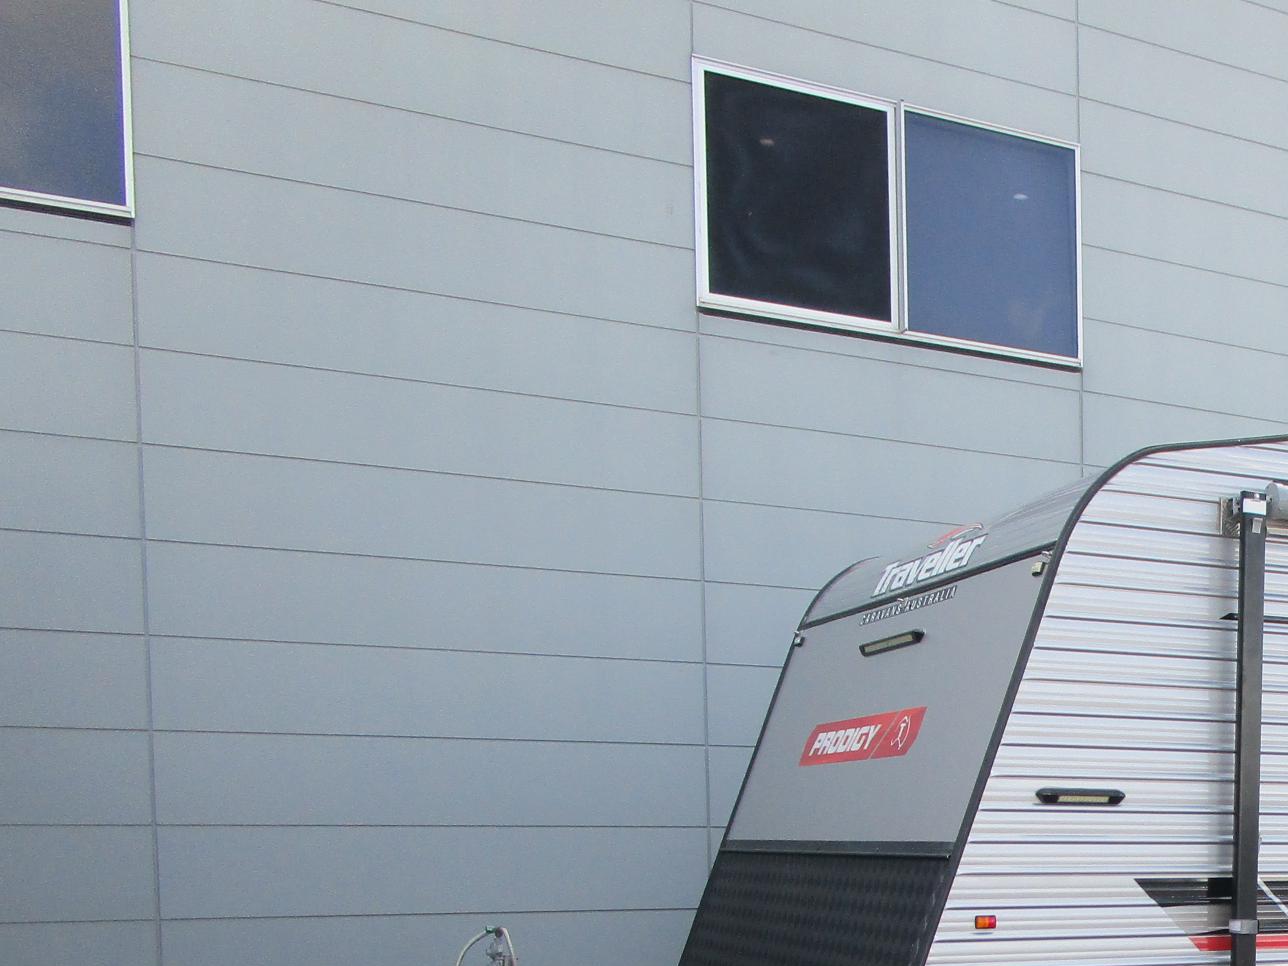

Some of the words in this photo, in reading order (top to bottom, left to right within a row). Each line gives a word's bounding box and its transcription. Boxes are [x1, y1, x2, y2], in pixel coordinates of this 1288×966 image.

[872, 534, 988, 598] Traveller
[903, 585, 958, 613] AUSTRALIA
[808, 723, 882, 757] PRODIGY
